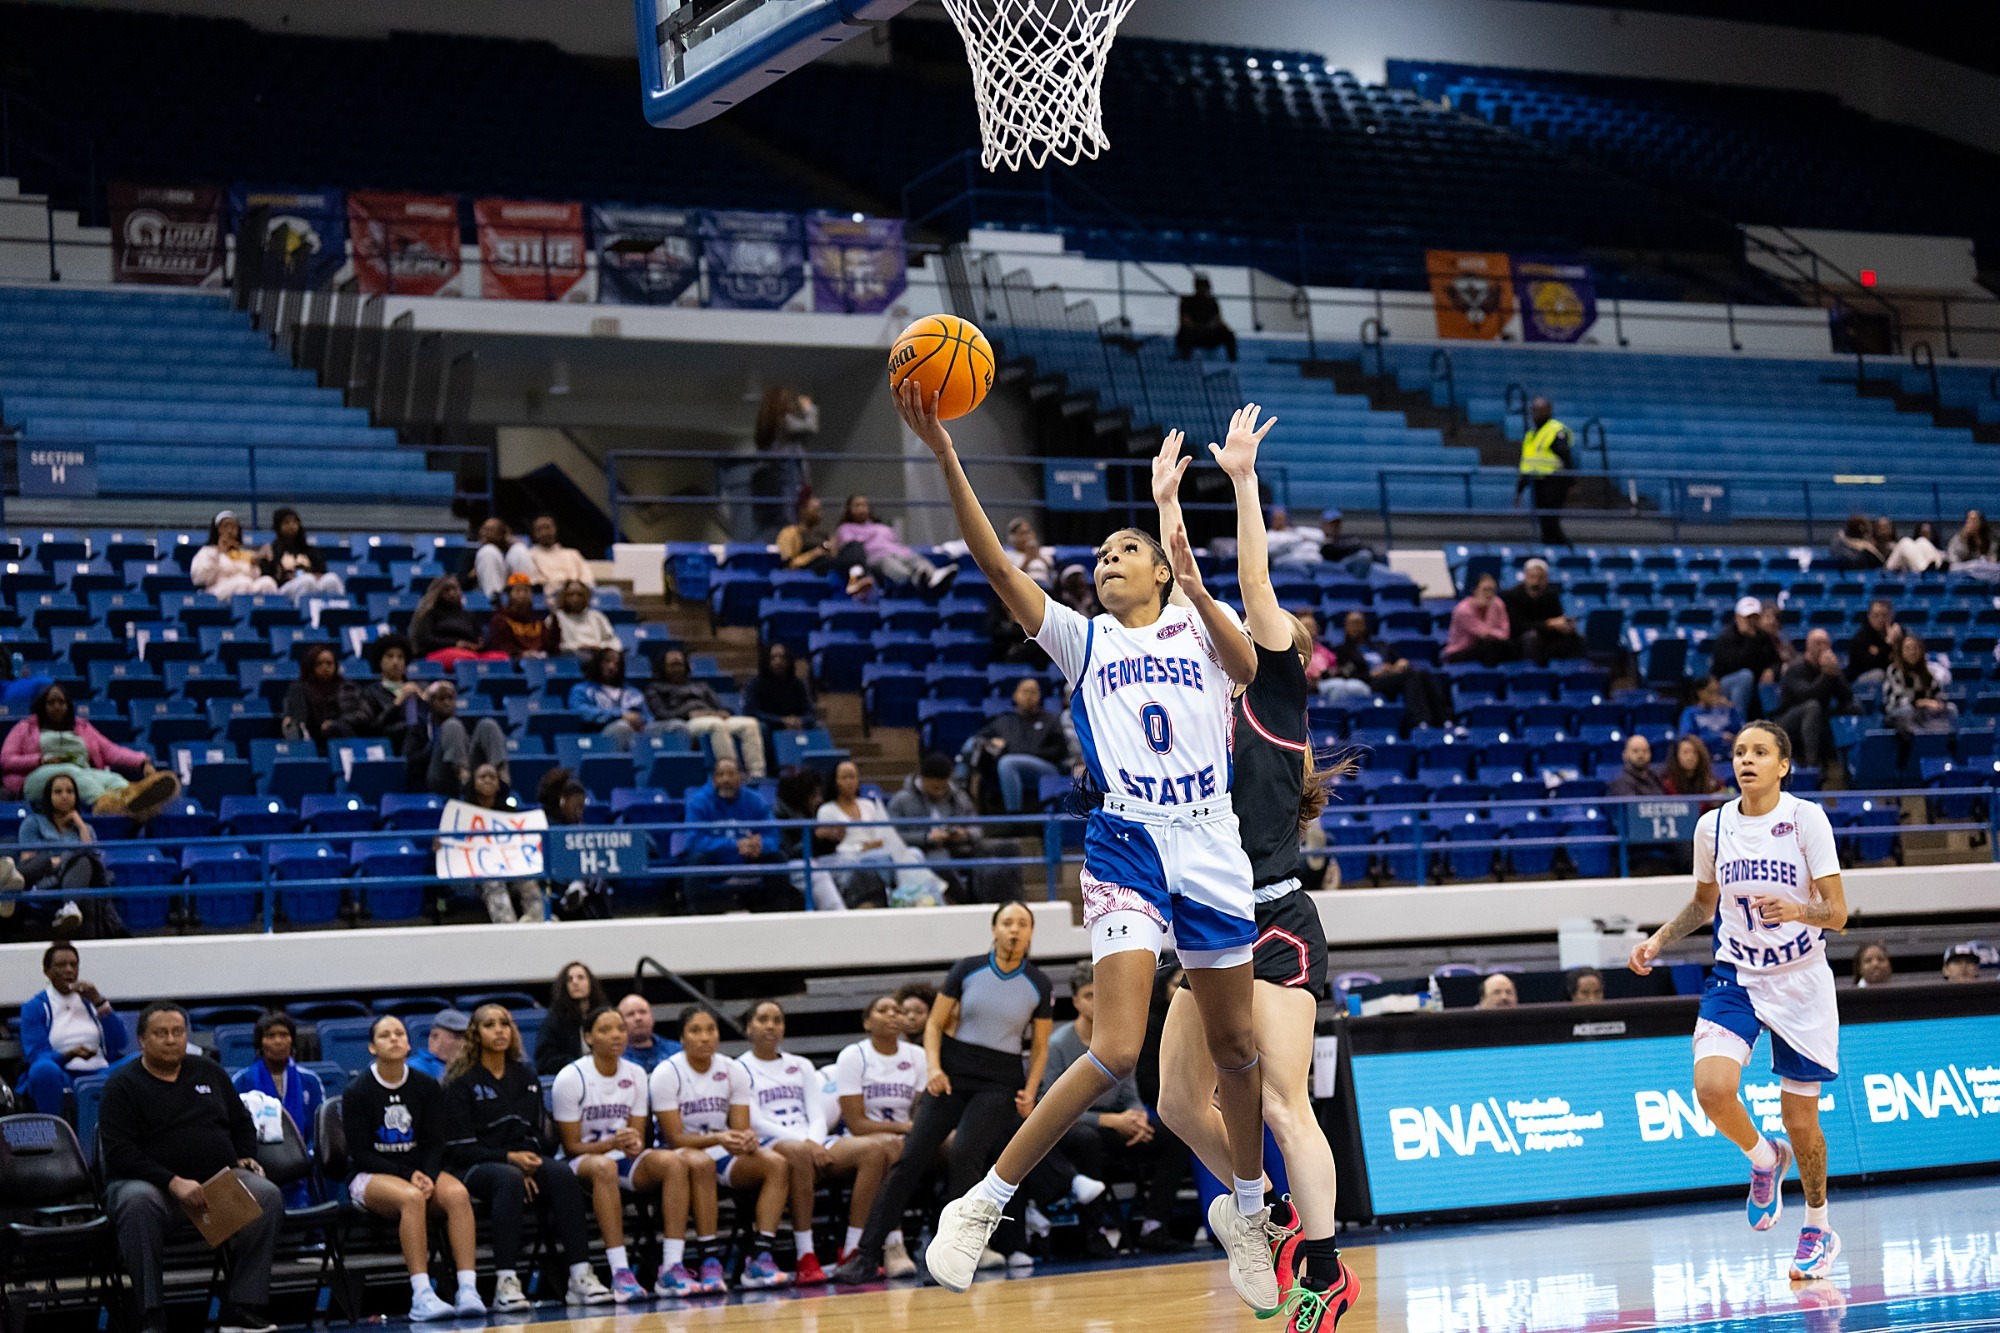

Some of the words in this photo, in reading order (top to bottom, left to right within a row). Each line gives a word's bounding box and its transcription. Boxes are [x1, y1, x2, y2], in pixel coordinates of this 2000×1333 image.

[51, 465, 66, 484] H
[1096, 653, 1205, 699] TENNESSEE
[1139, 701, 1173, 755] 0
[1118, 761, 1216, 806] STATE
[564, 831, 632, 850] SECTION
[580, 848, 621, 875] H-1
[1719, 858, 1798, 888] TENNESSEE
[1728, 926, 1813, 967] STATE
